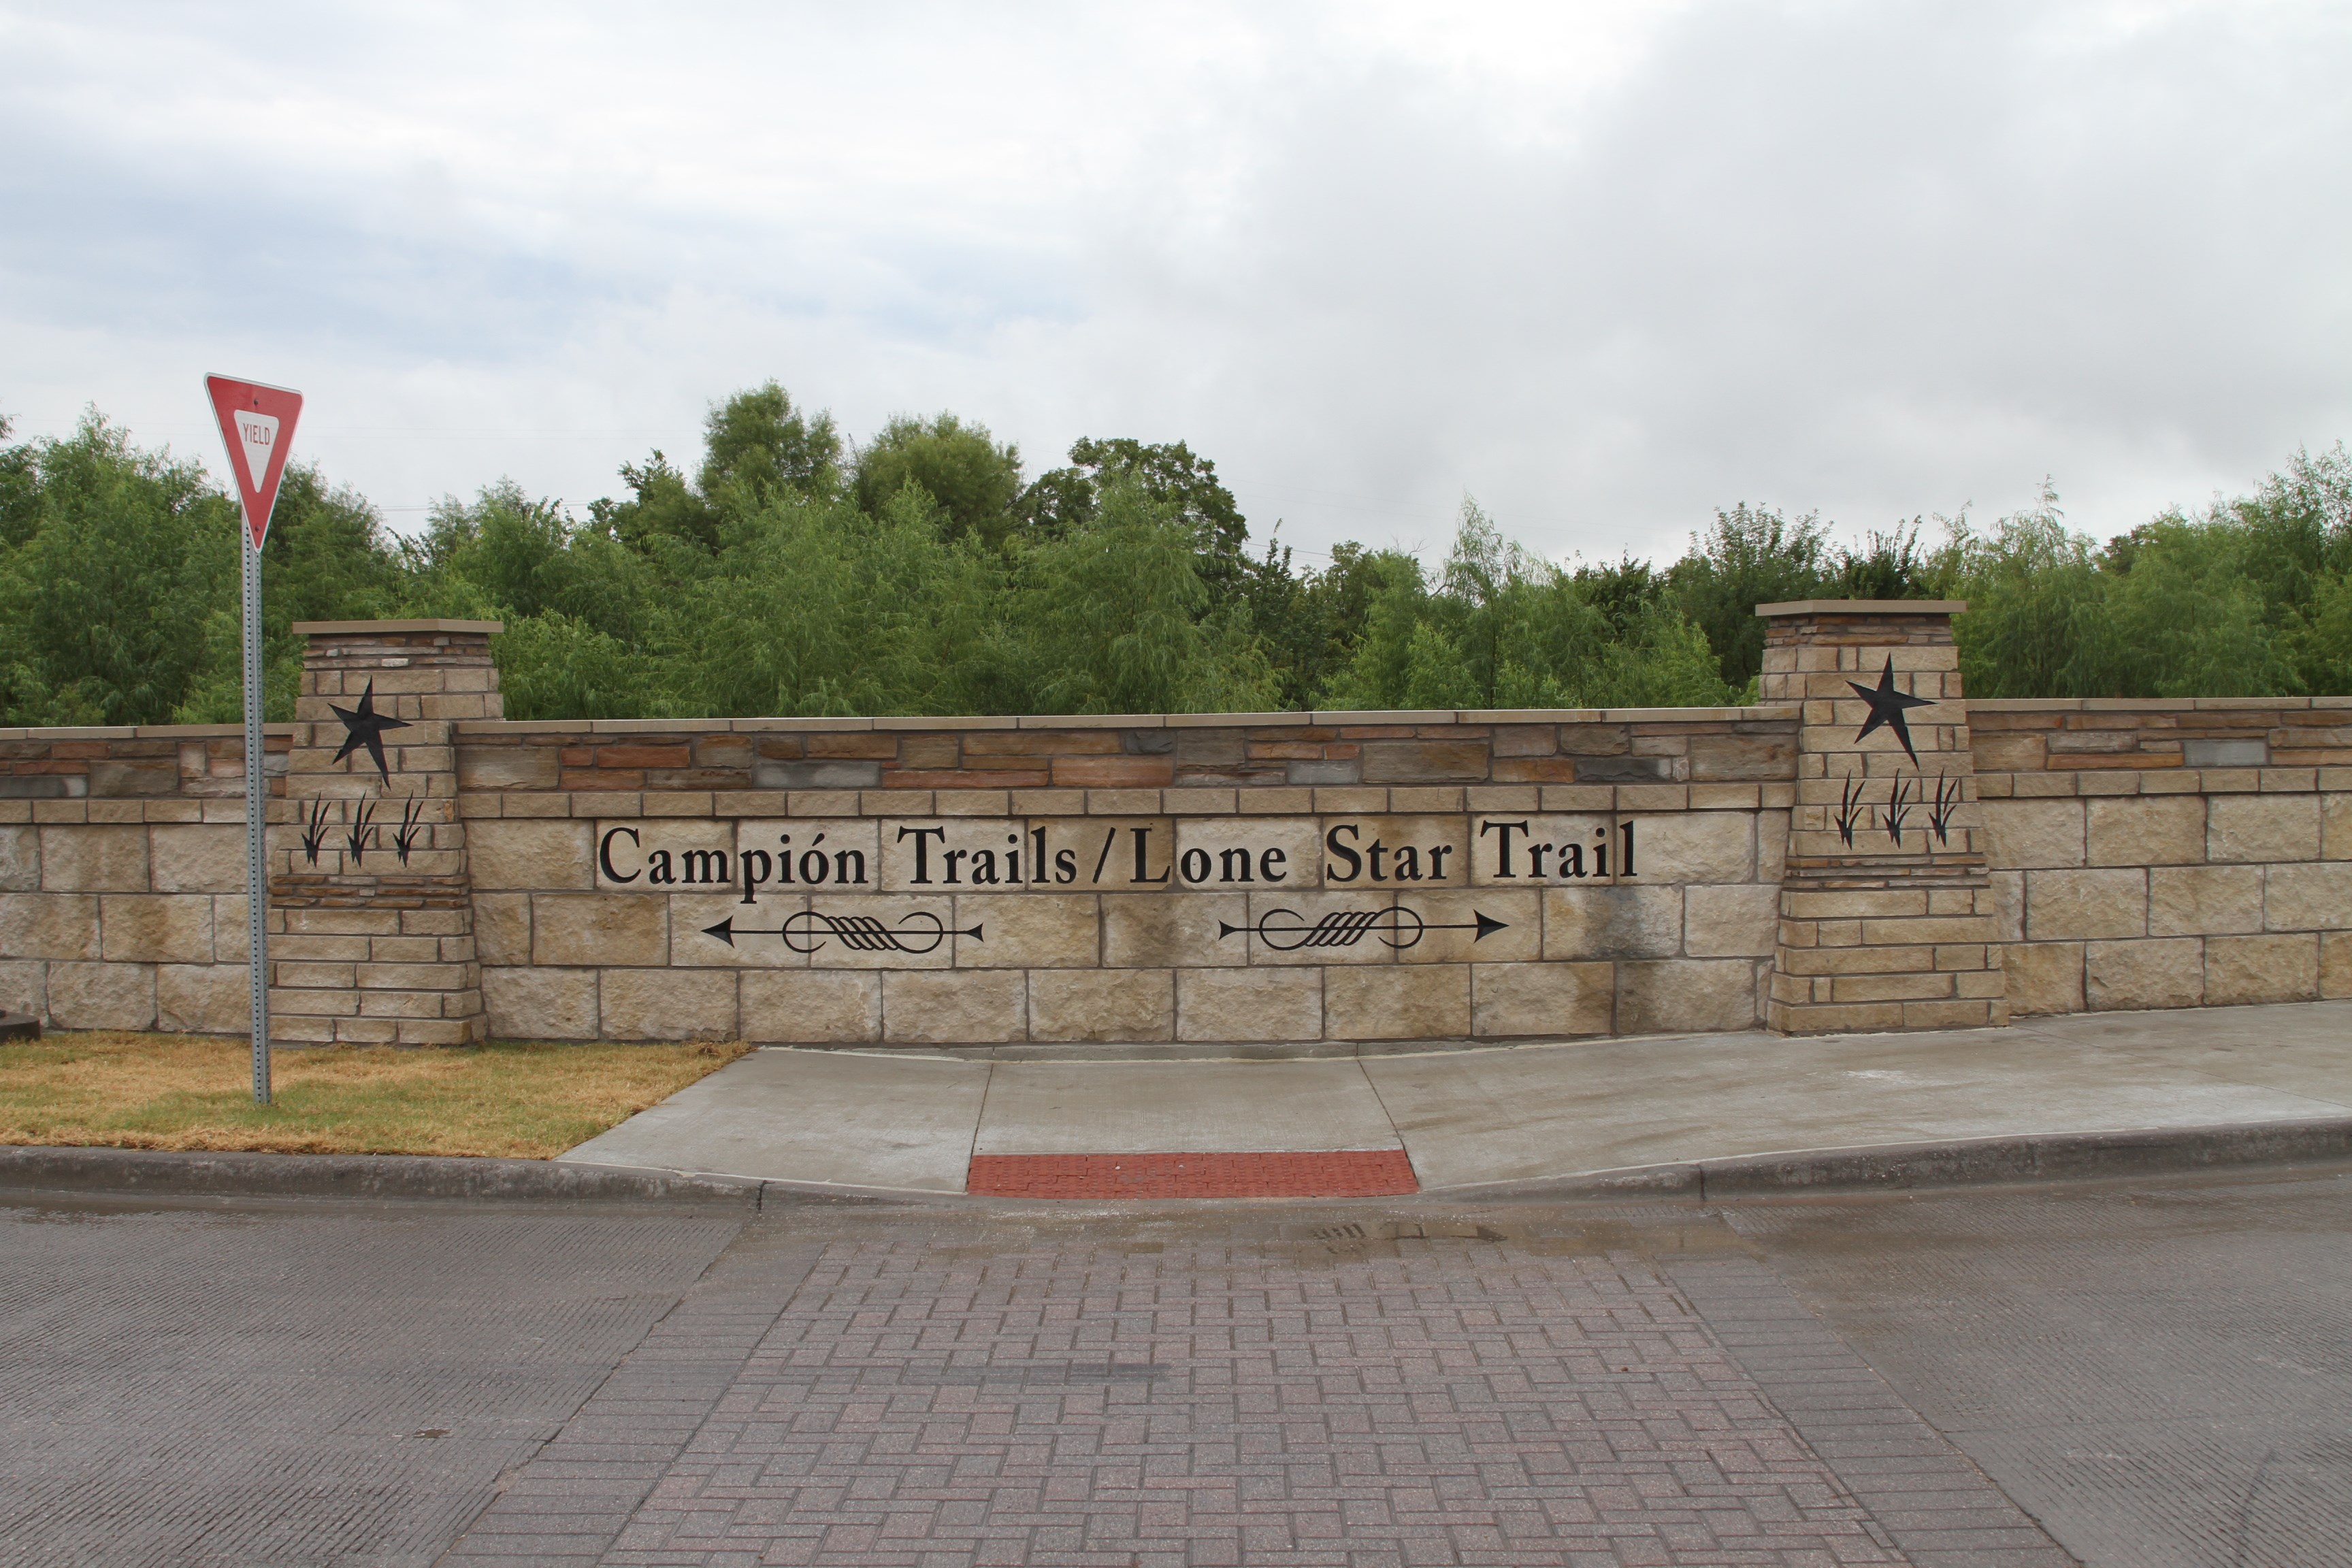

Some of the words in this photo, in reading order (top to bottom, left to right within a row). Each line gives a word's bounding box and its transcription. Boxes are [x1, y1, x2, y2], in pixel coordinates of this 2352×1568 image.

[242, 423, 270, 446] YIELD
[599, 826, 869, 904] Campión
[1326, 823, 1453, 883] Star
[1480, 819, 1638, 879] Trail
